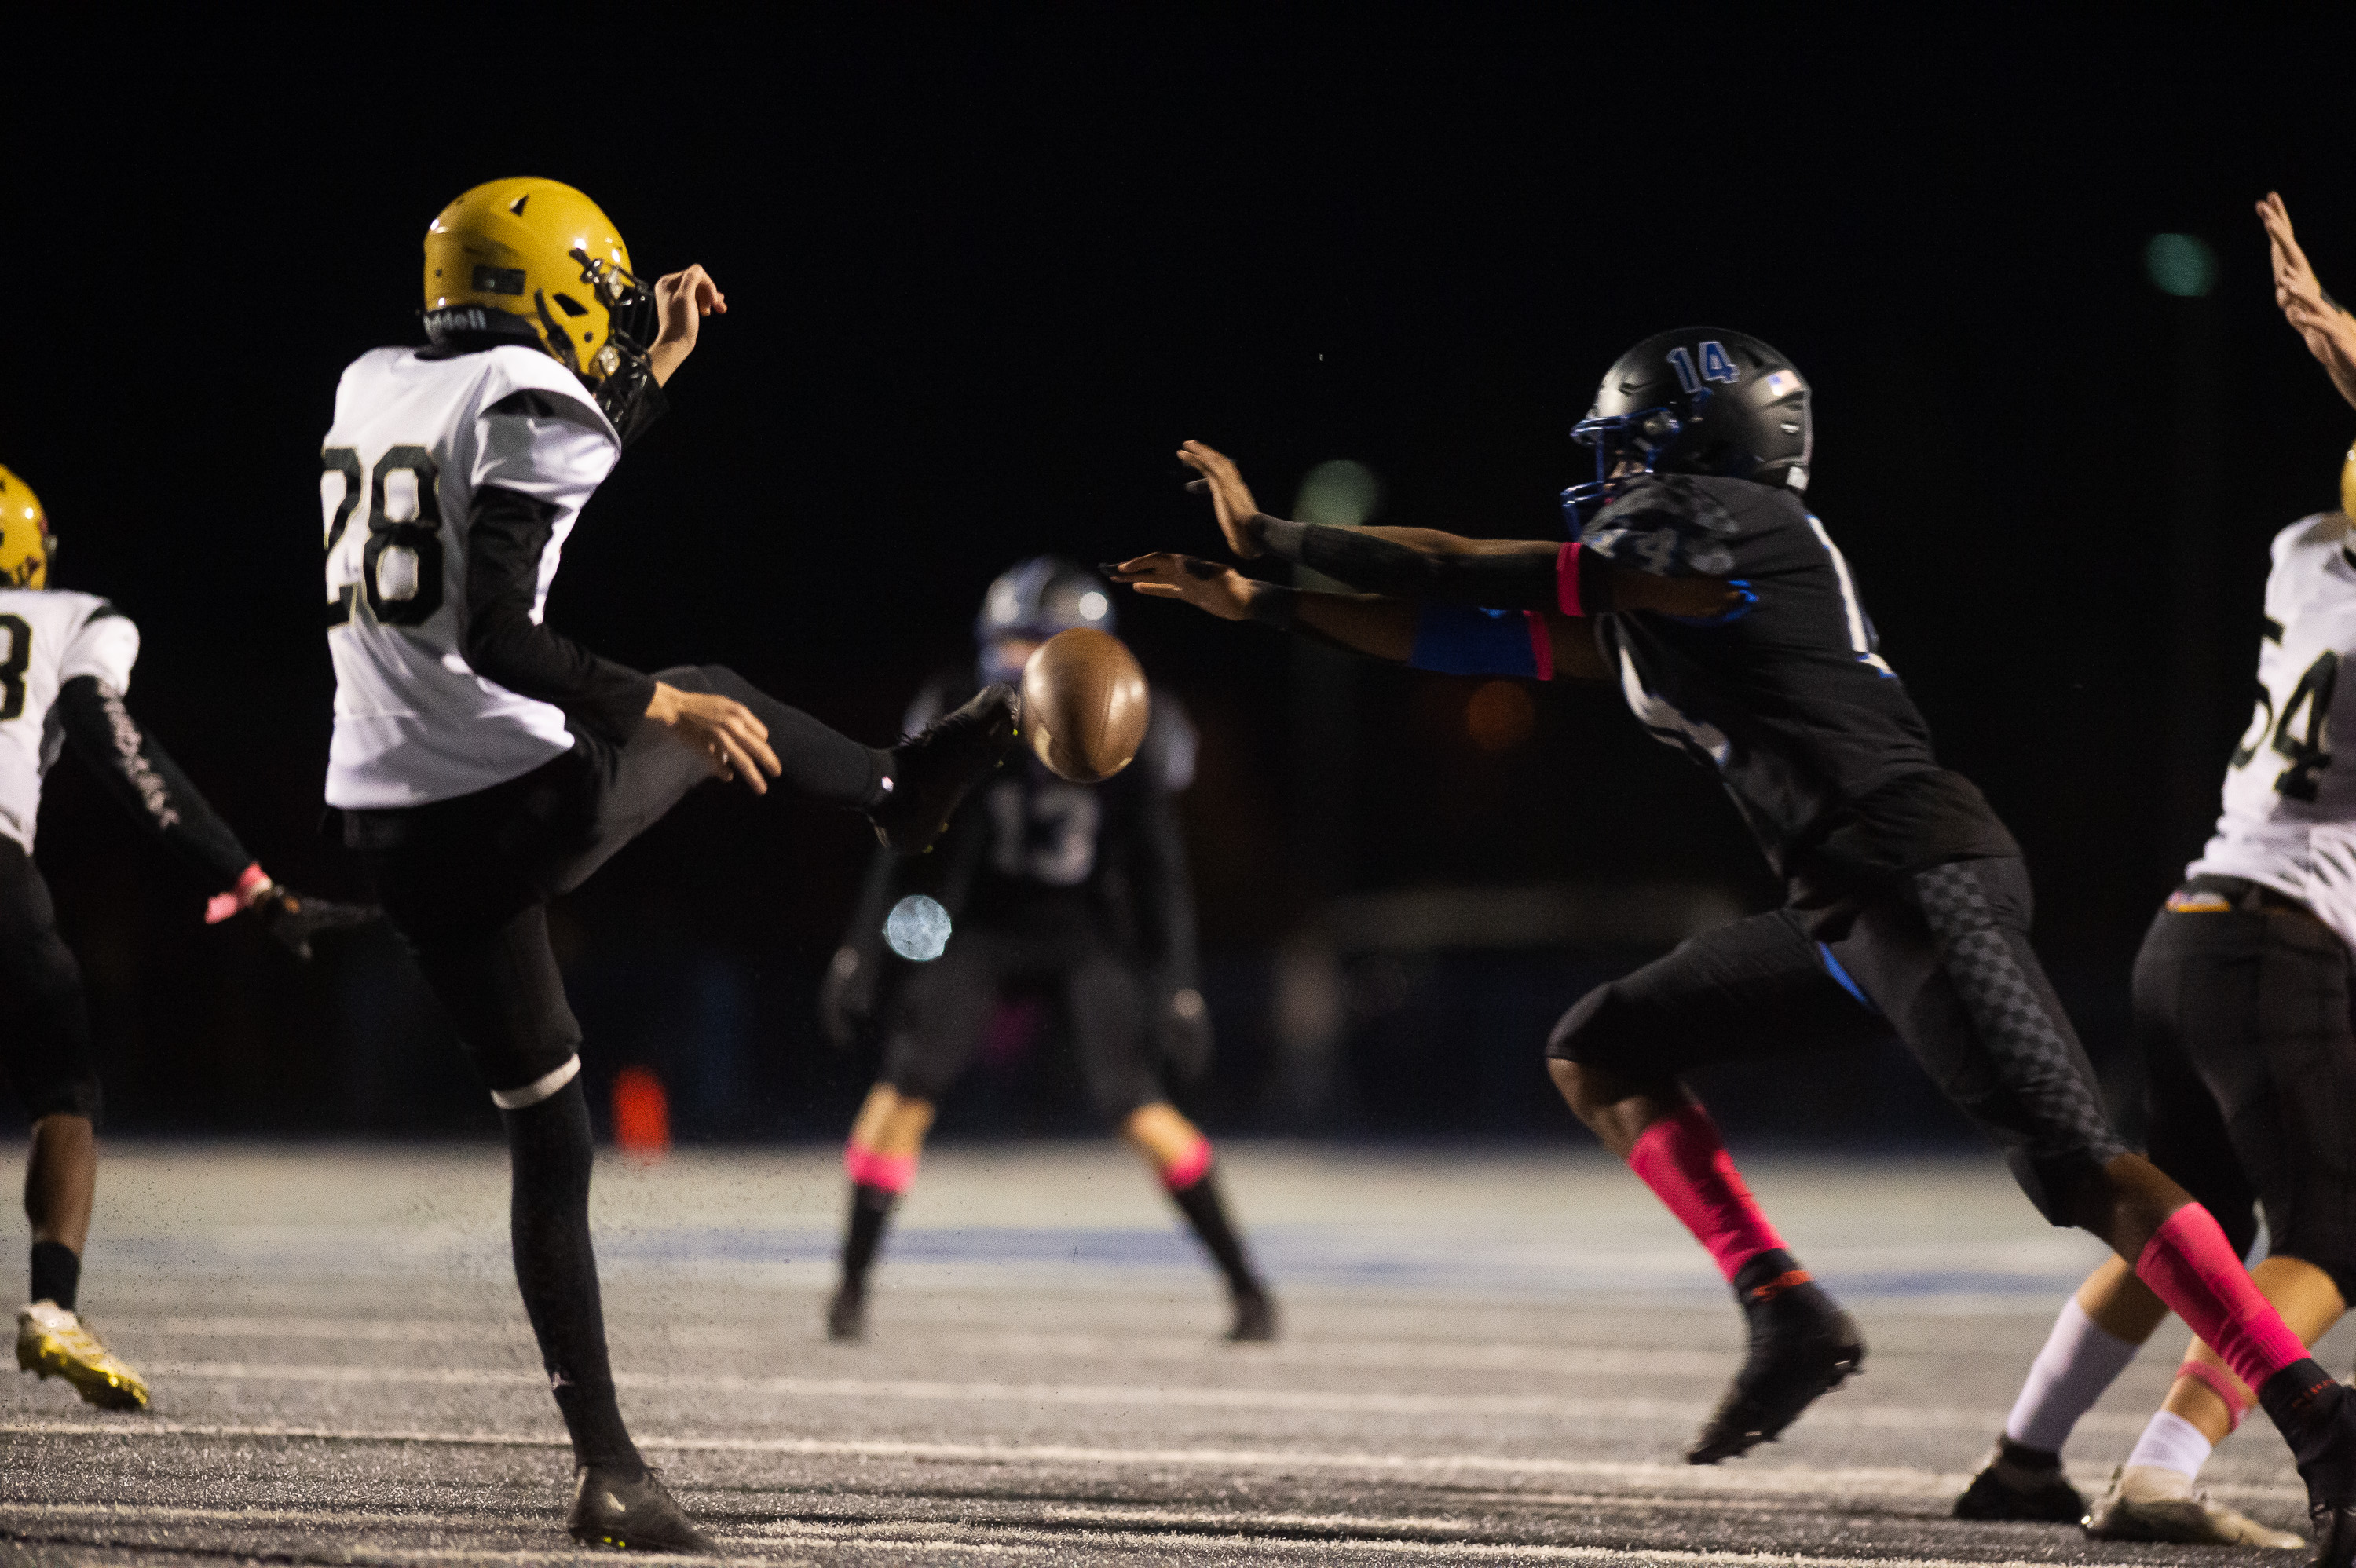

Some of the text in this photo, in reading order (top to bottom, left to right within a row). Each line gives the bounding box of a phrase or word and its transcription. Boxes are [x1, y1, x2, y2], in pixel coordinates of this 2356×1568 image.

[1666, 340, 1740, 394] 14
[320, 444, 444, 629] 28
[986, 781, 1100, 886] 13
